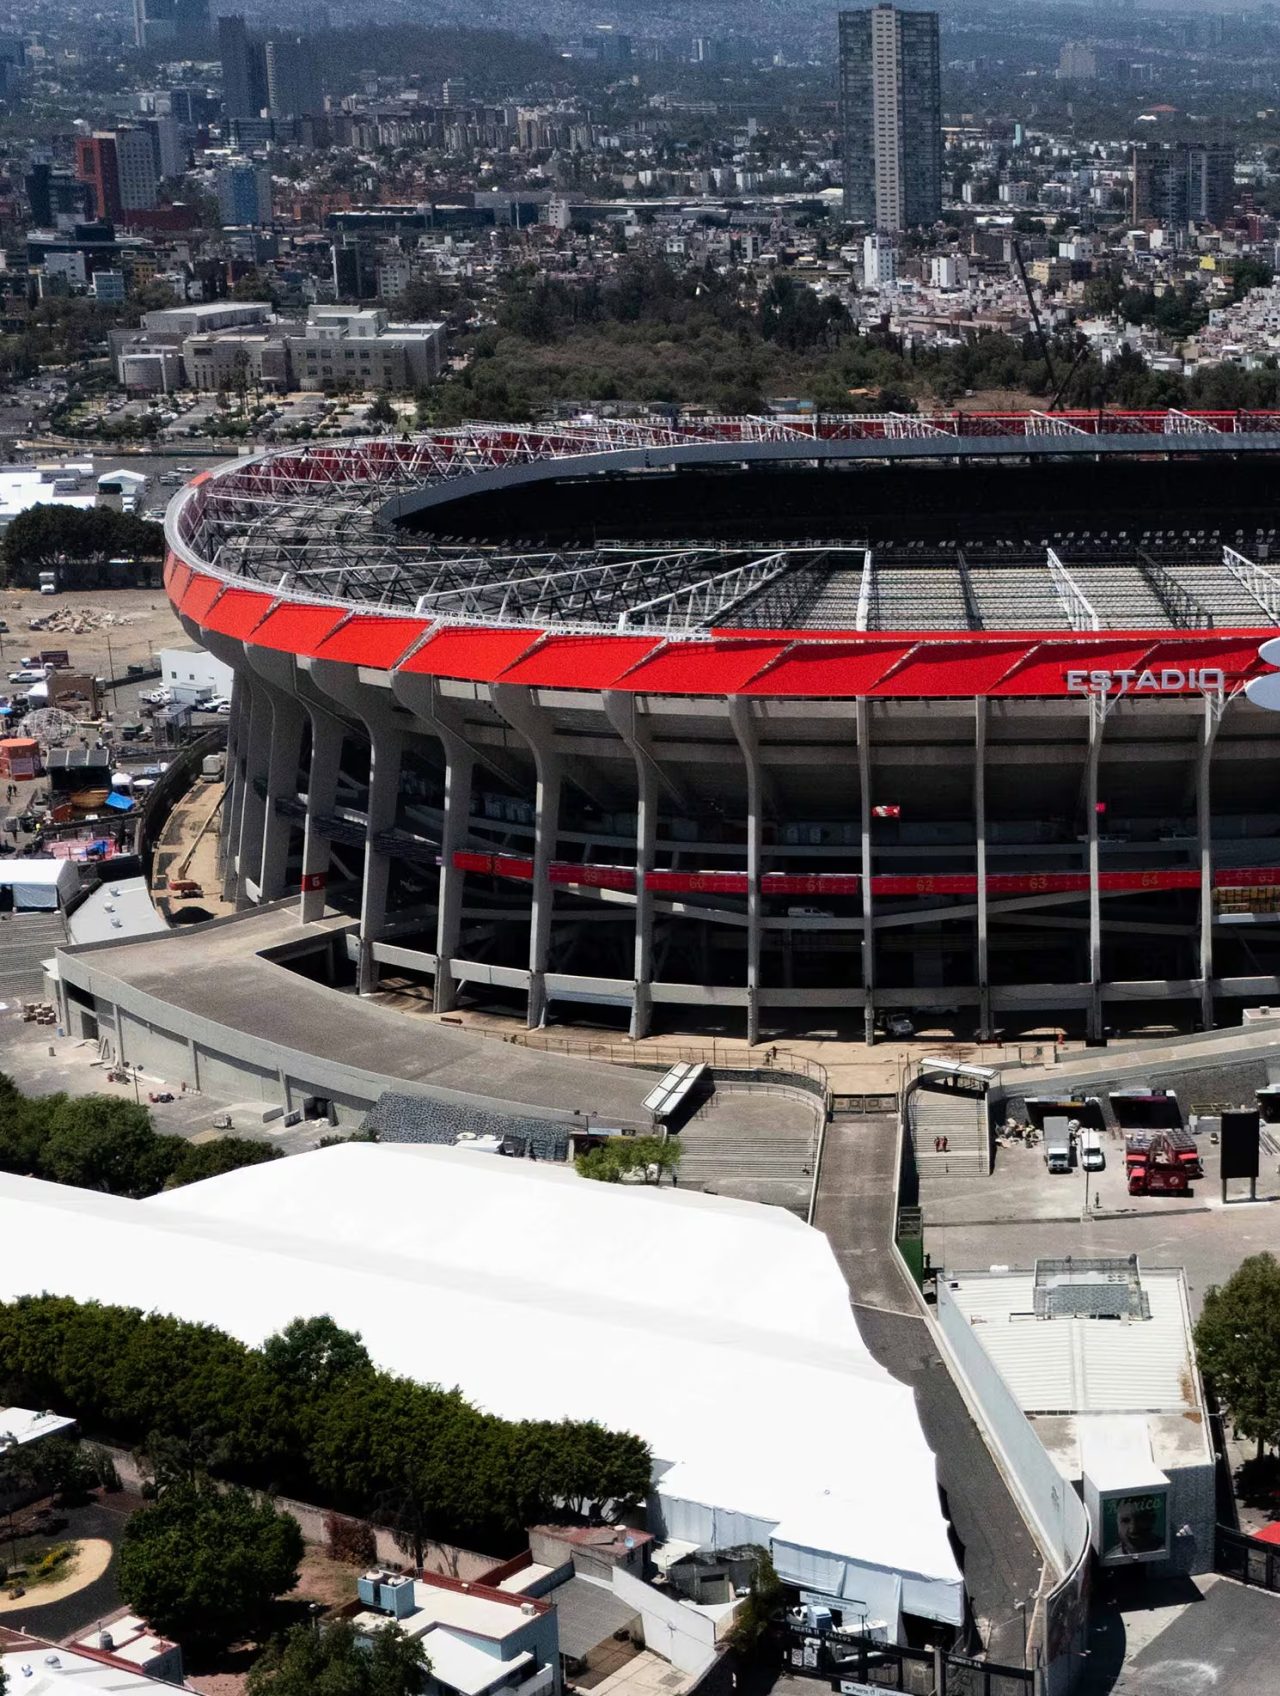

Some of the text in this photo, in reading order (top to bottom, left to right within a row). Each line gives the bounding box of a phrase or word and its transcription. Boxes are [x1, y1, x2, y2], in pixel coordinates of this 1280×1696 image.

[1066, 669, 1225, 692] ESTADIO
[916, 879, 934, 892] 62
[1029, 877, 1048, 889] 63
